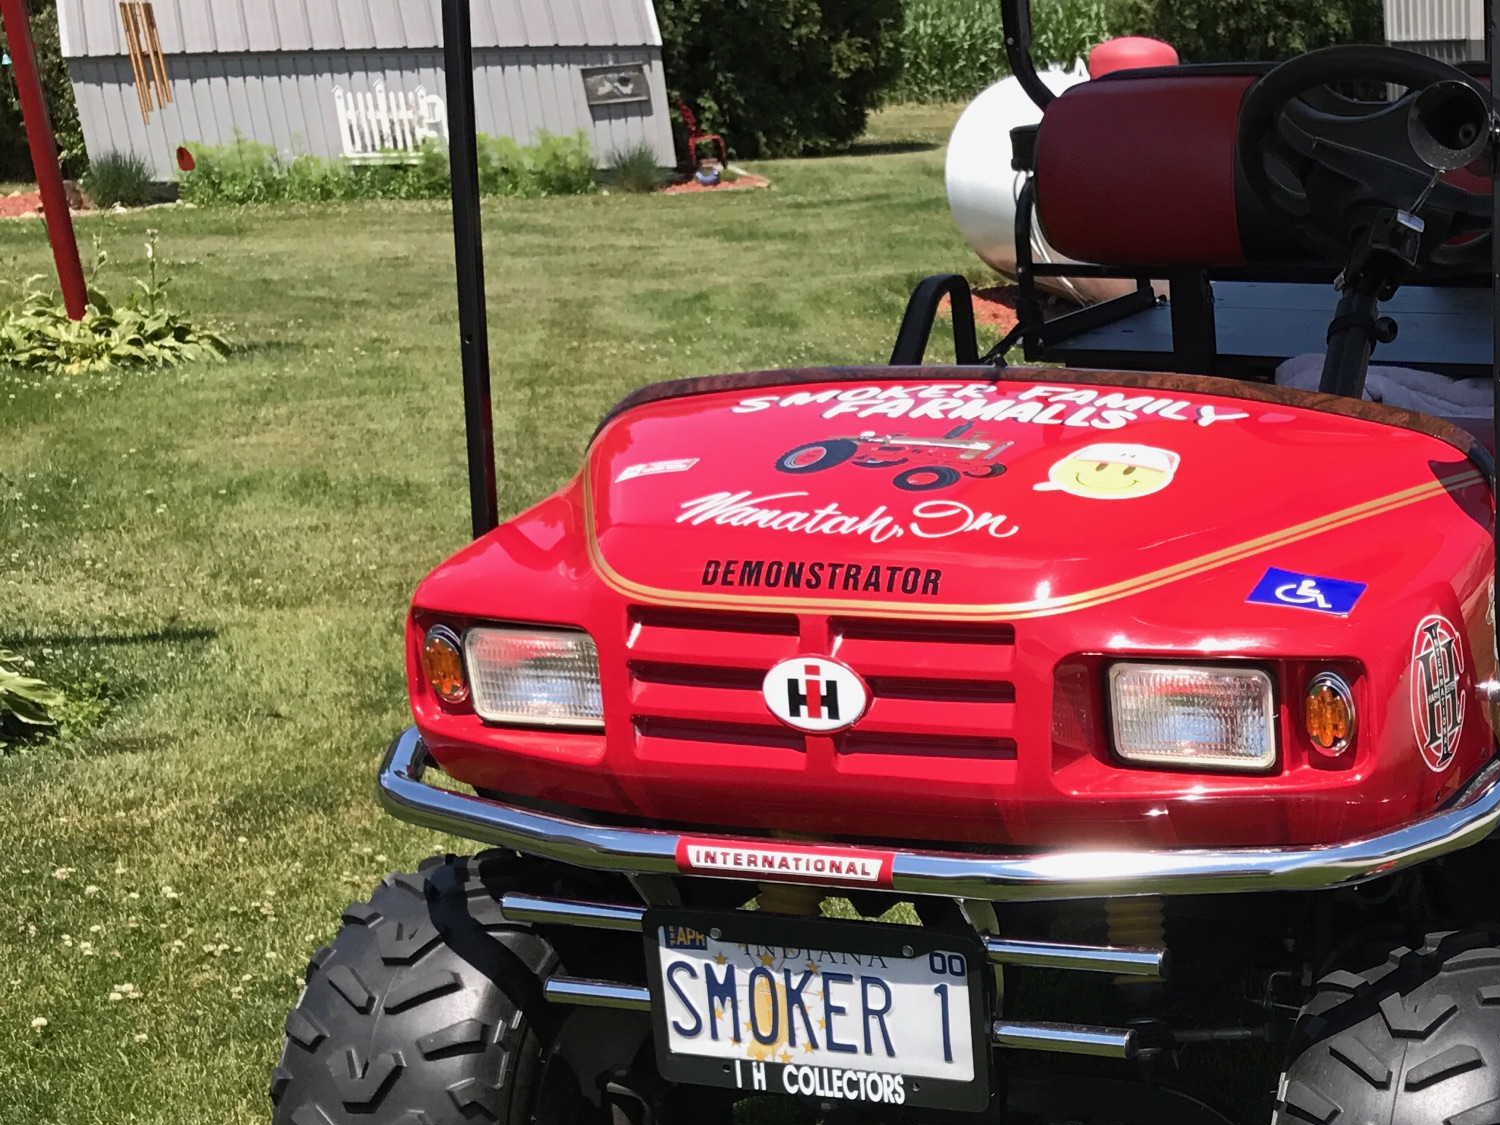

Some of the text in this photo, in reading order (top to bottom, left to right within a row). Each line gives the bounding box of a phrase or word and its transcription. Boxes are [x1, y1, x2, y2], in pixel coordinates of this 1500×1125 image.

[732, 384, 1250, 426] SMOKER FAMILY
[822, 398, 1140, 430] FARMALLS
[675, 491, 904, 543] Wanatah,
[702, 559, 942, 596] DEMONSTRATOR
[695, 849, 872, 878] INTERNATIONAL
[666, 960, 954, 1063] SMOKER 1
[734, 1060, 906, 1105] I H COLLECTORS
